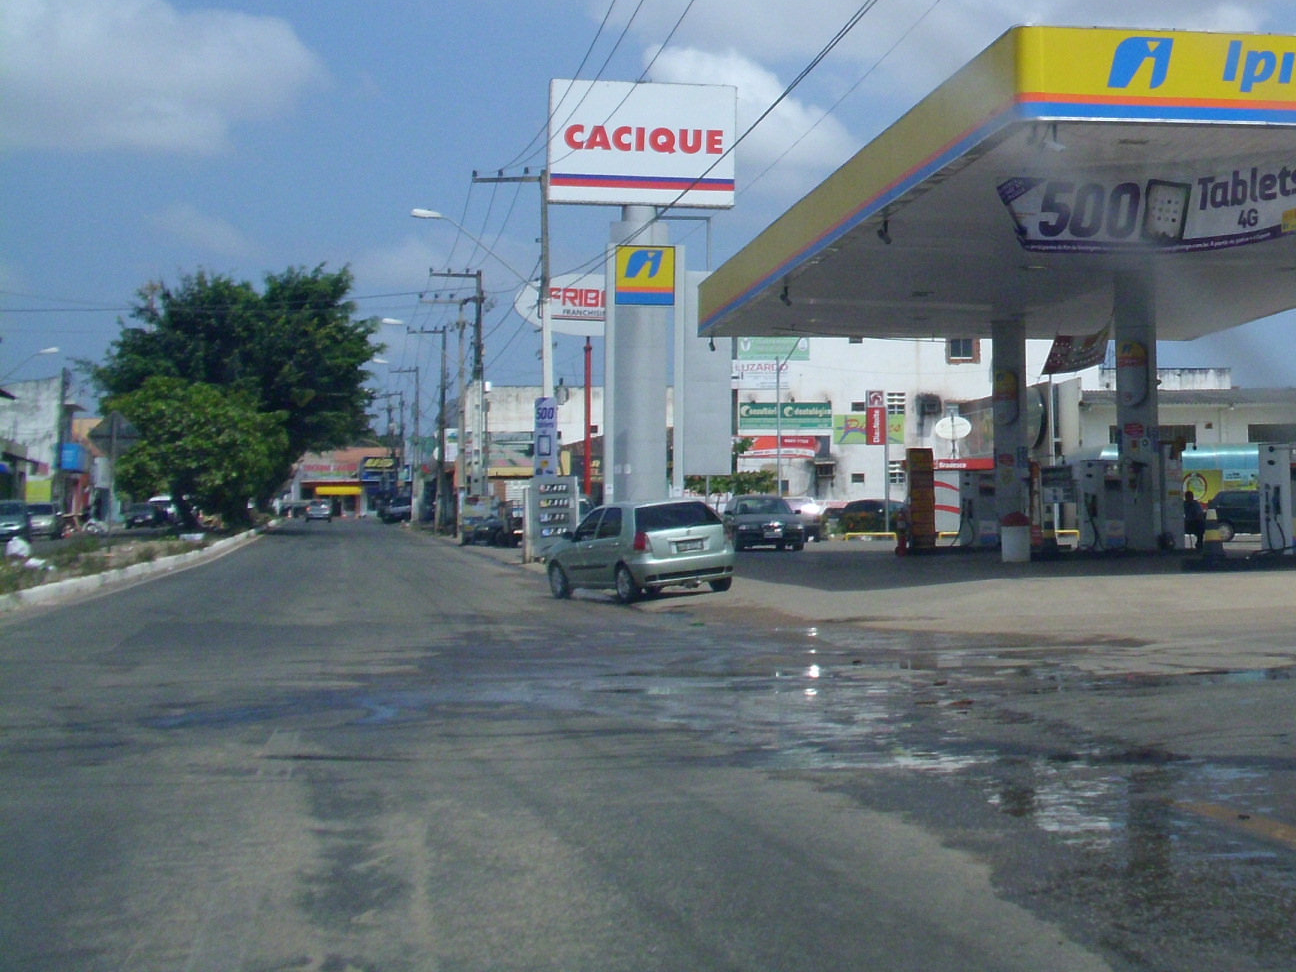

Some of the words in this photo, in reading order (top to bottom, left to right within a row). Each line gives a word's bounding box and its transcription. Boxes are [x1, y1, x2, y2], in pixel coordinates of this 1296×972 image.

[563, 124, 724, 155] CACIQUE
[1039, 181, 1141, 239] 500
[1238, 208, 1259, 228] 4G
